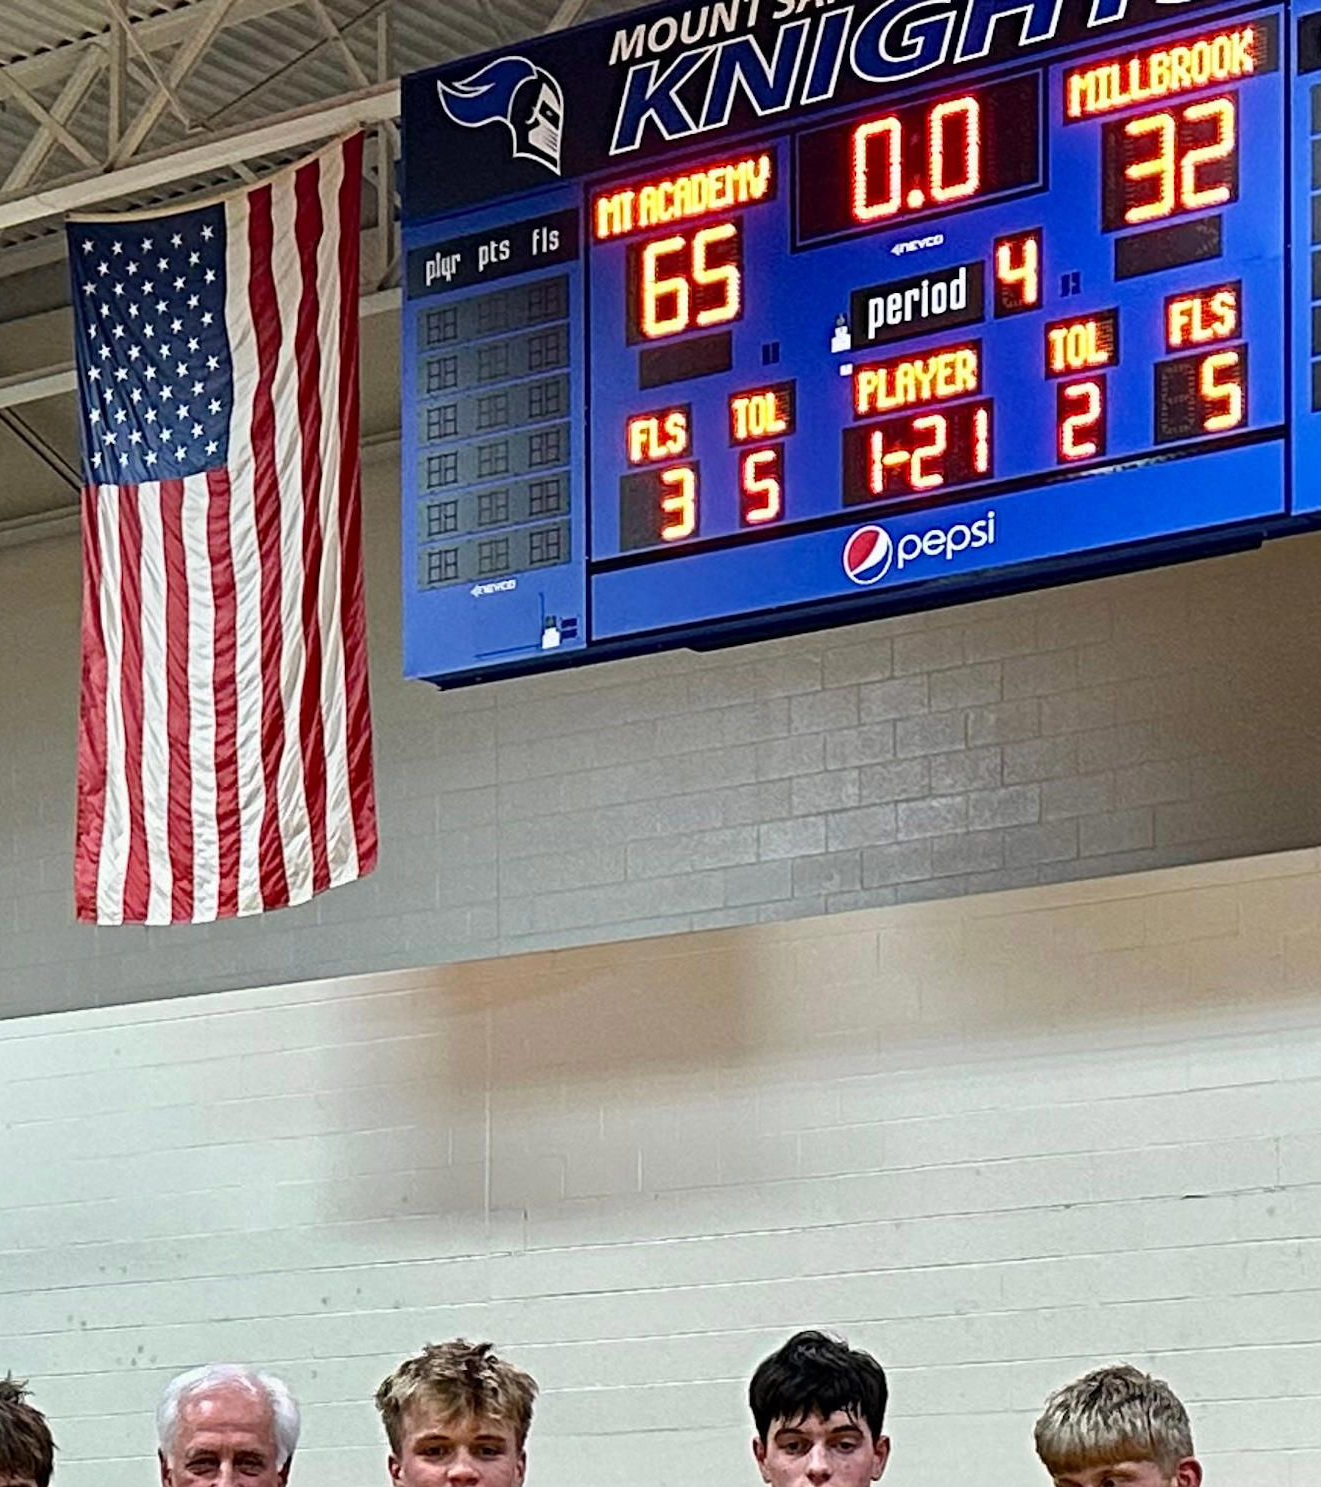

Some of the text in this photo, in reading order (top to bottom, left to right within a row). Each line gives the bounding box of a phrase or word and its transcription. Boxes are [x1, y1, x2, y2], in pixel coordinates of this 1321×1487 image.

[610, 0, 1190, 155] KNIGH
[1067, 27, 1258, 118] MILLBROOK
[597, 154, 771, 239] MT ACADEMY
[853, 97, 979, 222] 0.0
[1124, 97, 1235, 224] 32
[424, 227, 559, 286] plyr pts fls
[640, 223, 740, 339] 65
[995, 237, 1038, 304] 4
[867, 267, 967, 339] period
[1169, 290, 1236, 346] FLS
[858, 350, 977, 413] PLAYER
[1048, 320, 1108, 371] TOL
[732, 392, 786, 438] TOL
[1061, 381, 1101, 459] 2
[1199, 350, 1242, 433] 5
[629, 414, 686, 462] FLS
[660, 467, 696, 541] 3
[743, 449, 780, 523] 5
[897, 511, 996, 569] pepsi
